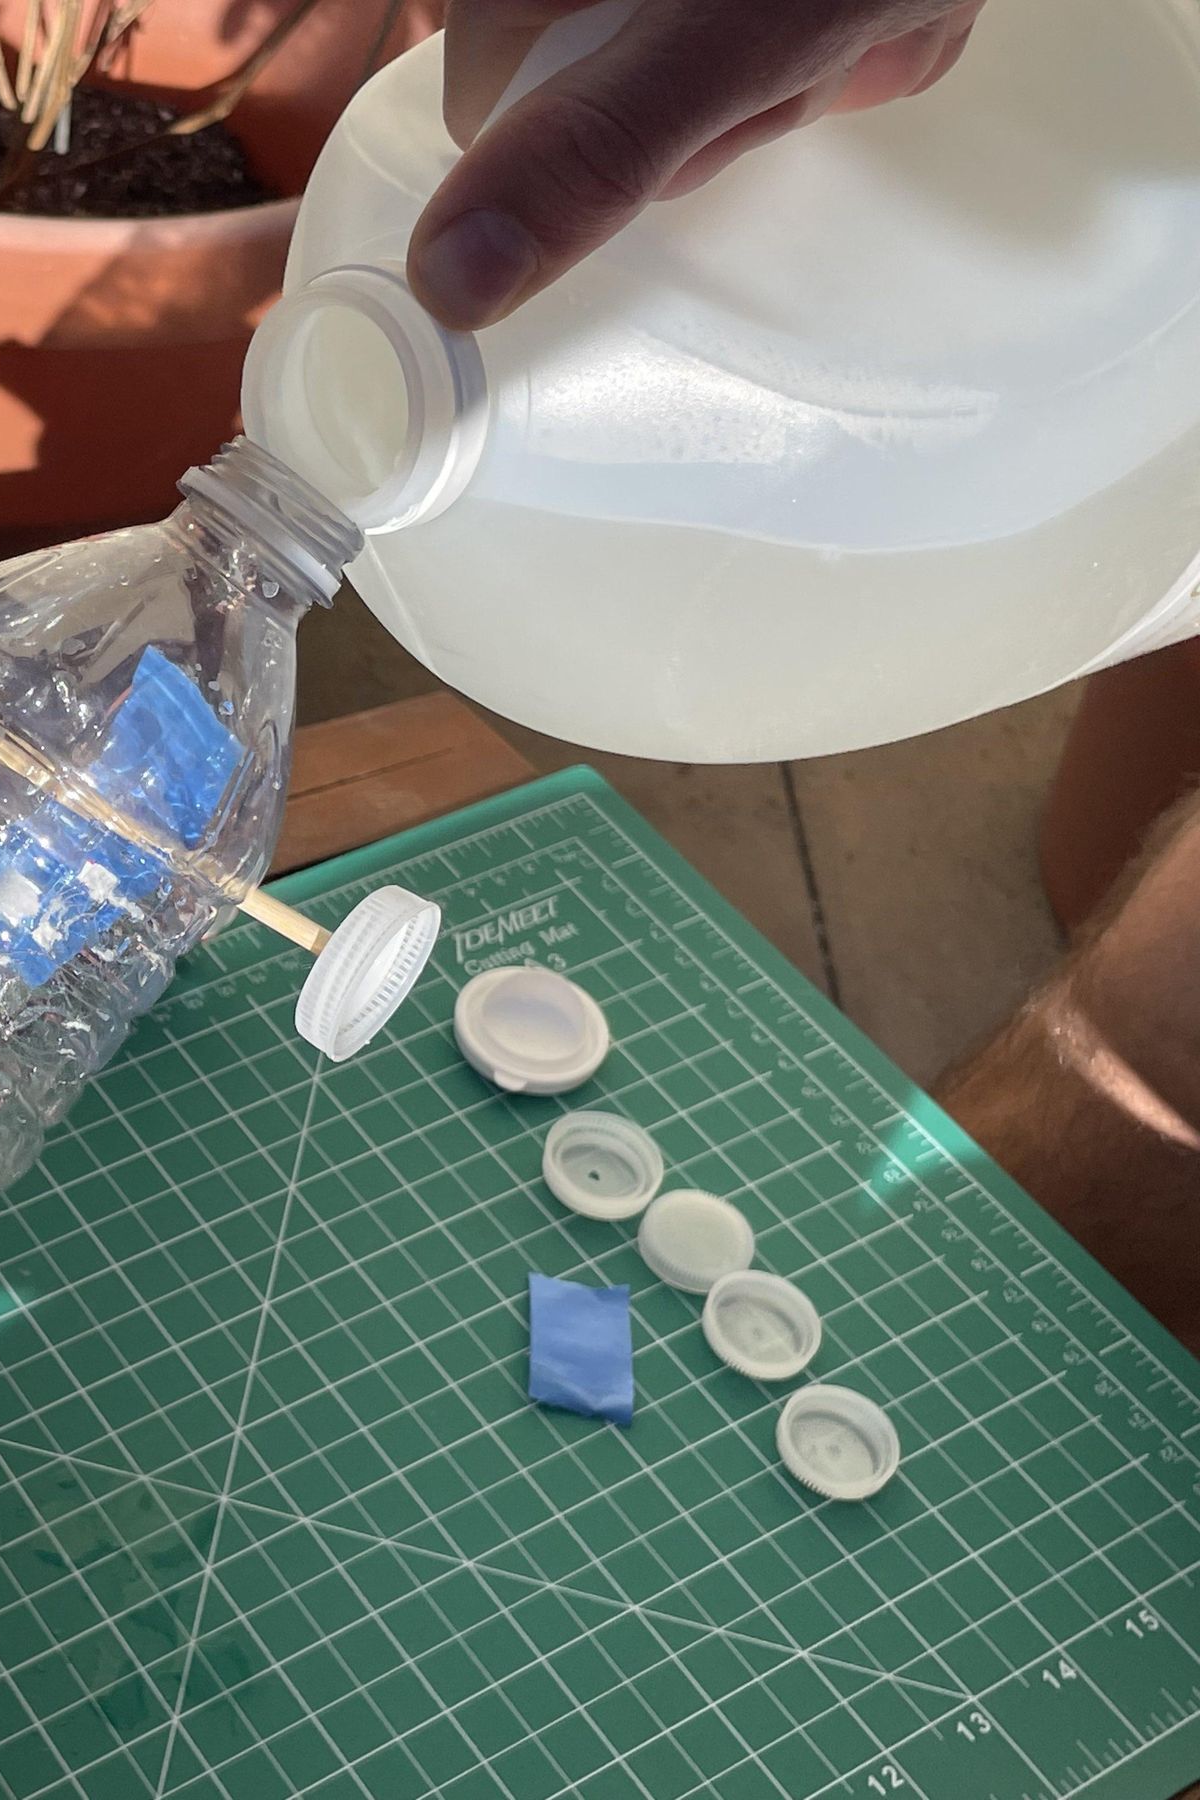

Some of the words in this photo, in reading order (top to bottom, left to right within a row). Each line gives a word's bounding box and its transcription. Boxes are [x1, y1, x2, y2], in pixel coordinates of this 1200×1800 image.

[539, 922, 579, 947] Mat
[1125, 1609, 1160, 1639] 15
[1042, 1659, 1078, 1690] 14
[956, 1711, 992, 1743] 13
[867, 1764, 905, 1797] 12
